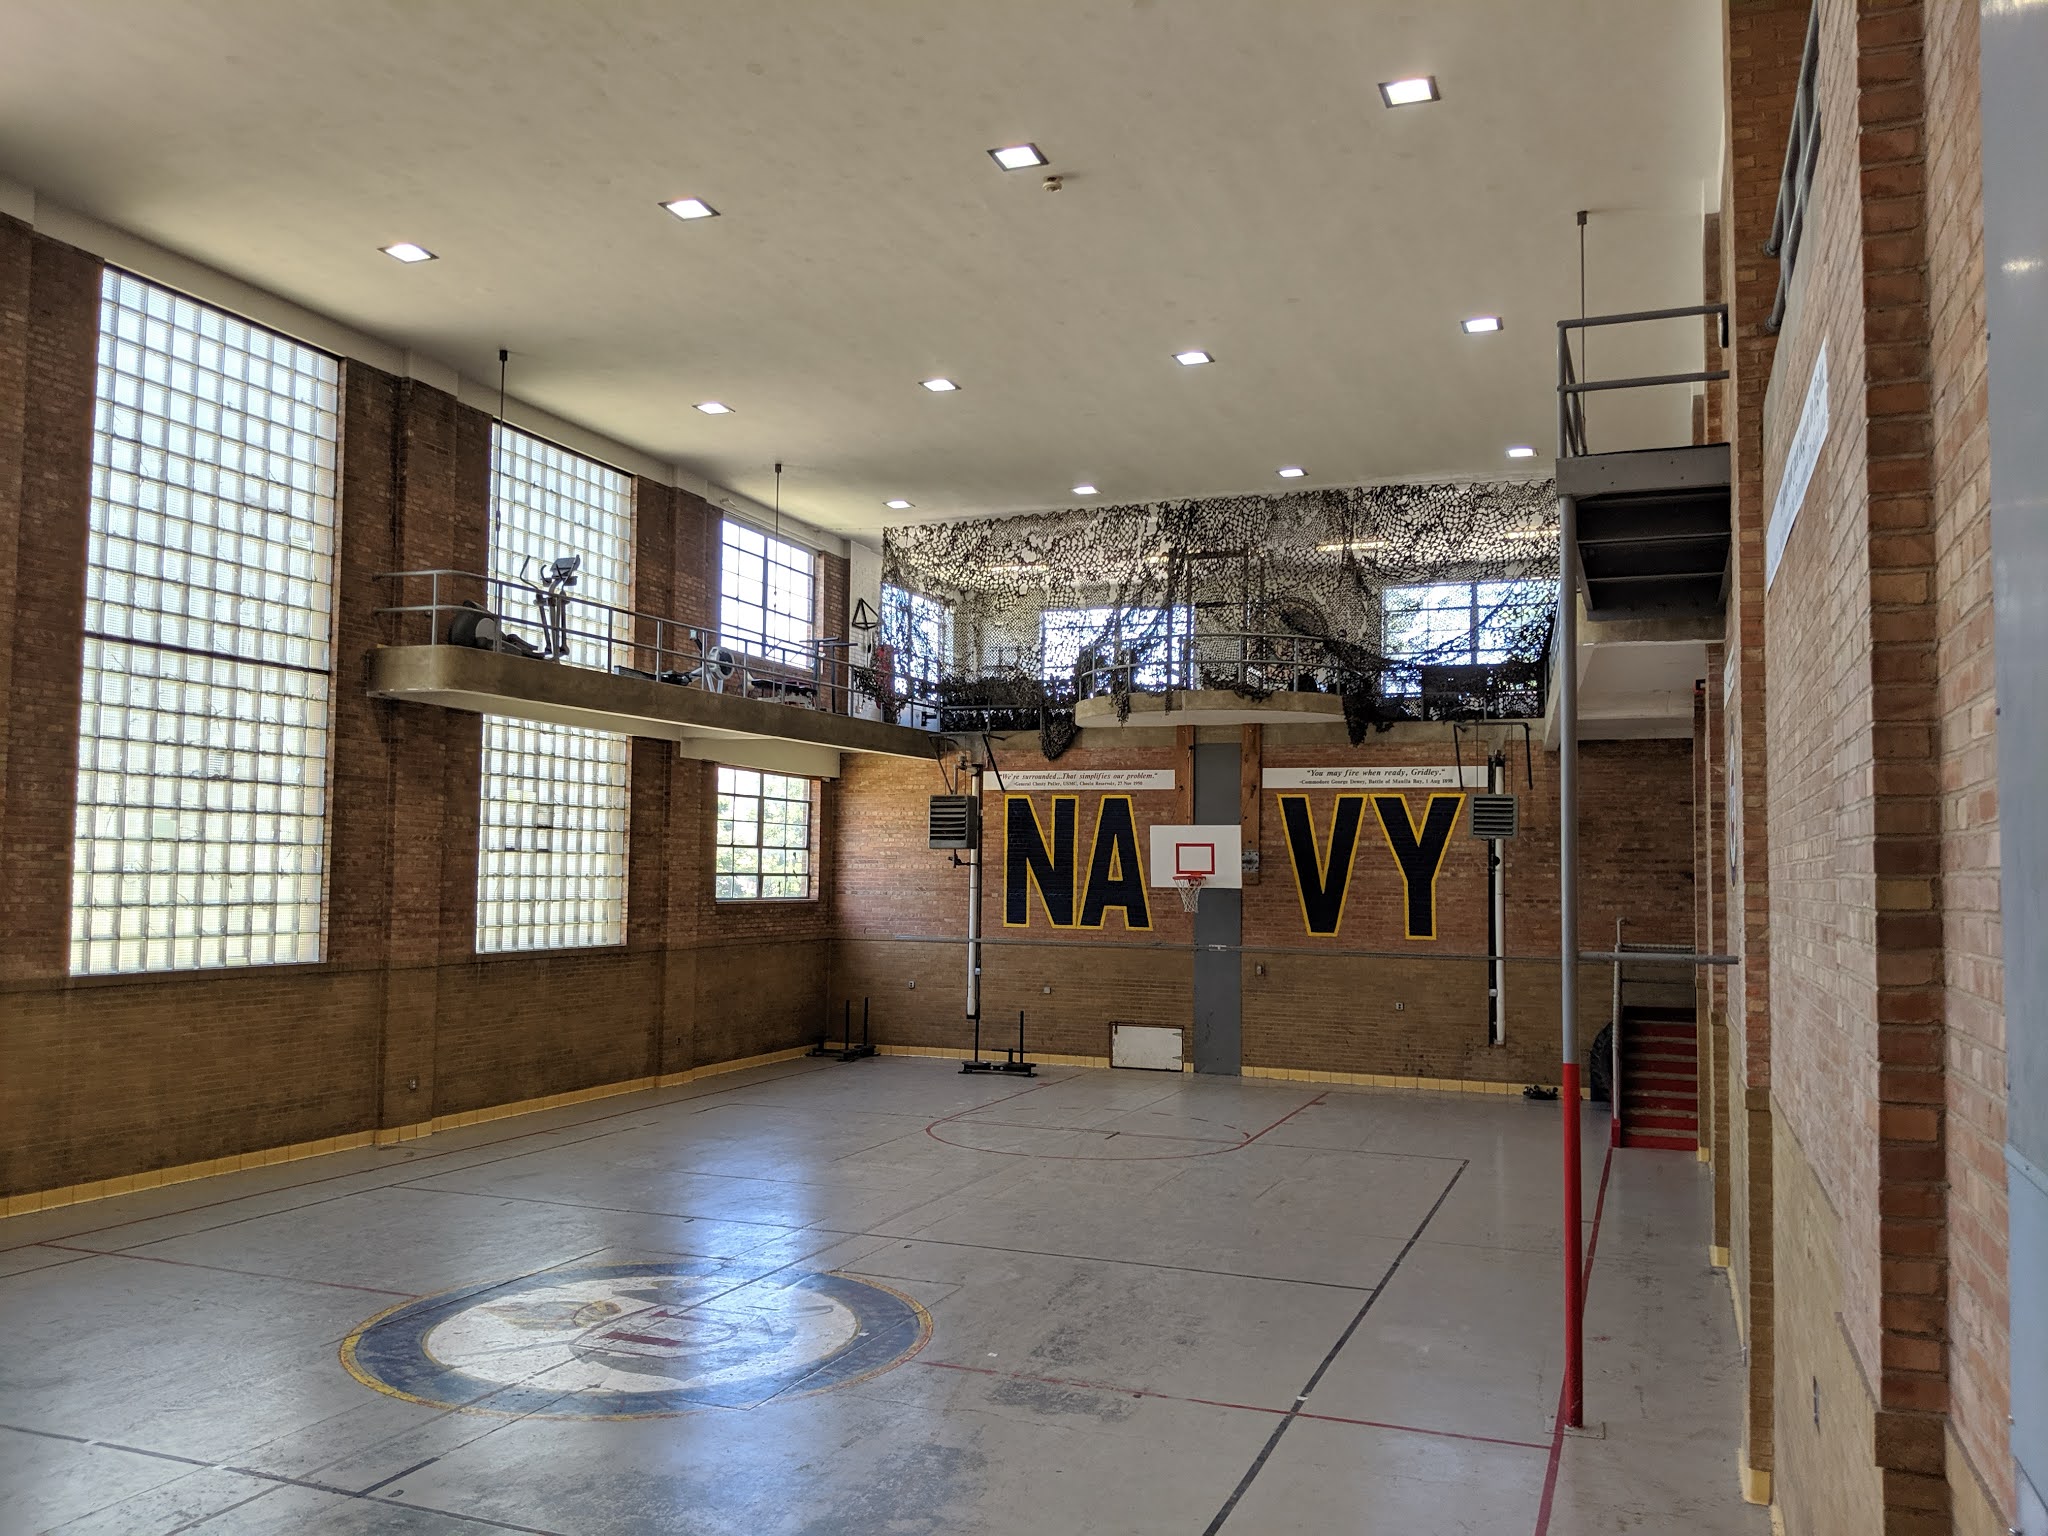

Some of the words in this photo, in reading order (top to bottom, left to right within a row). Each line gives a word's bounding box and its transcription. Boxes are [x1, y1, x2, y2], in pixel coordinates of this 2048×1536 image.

[1079, 772, 1111, 780] simplifies
[1326, 770, 1343, 778] may
[1343, 769, 1360, 778] fire
[1362, 768, 1382, 776] when
[1384, 768, 1408, 777] ready,
